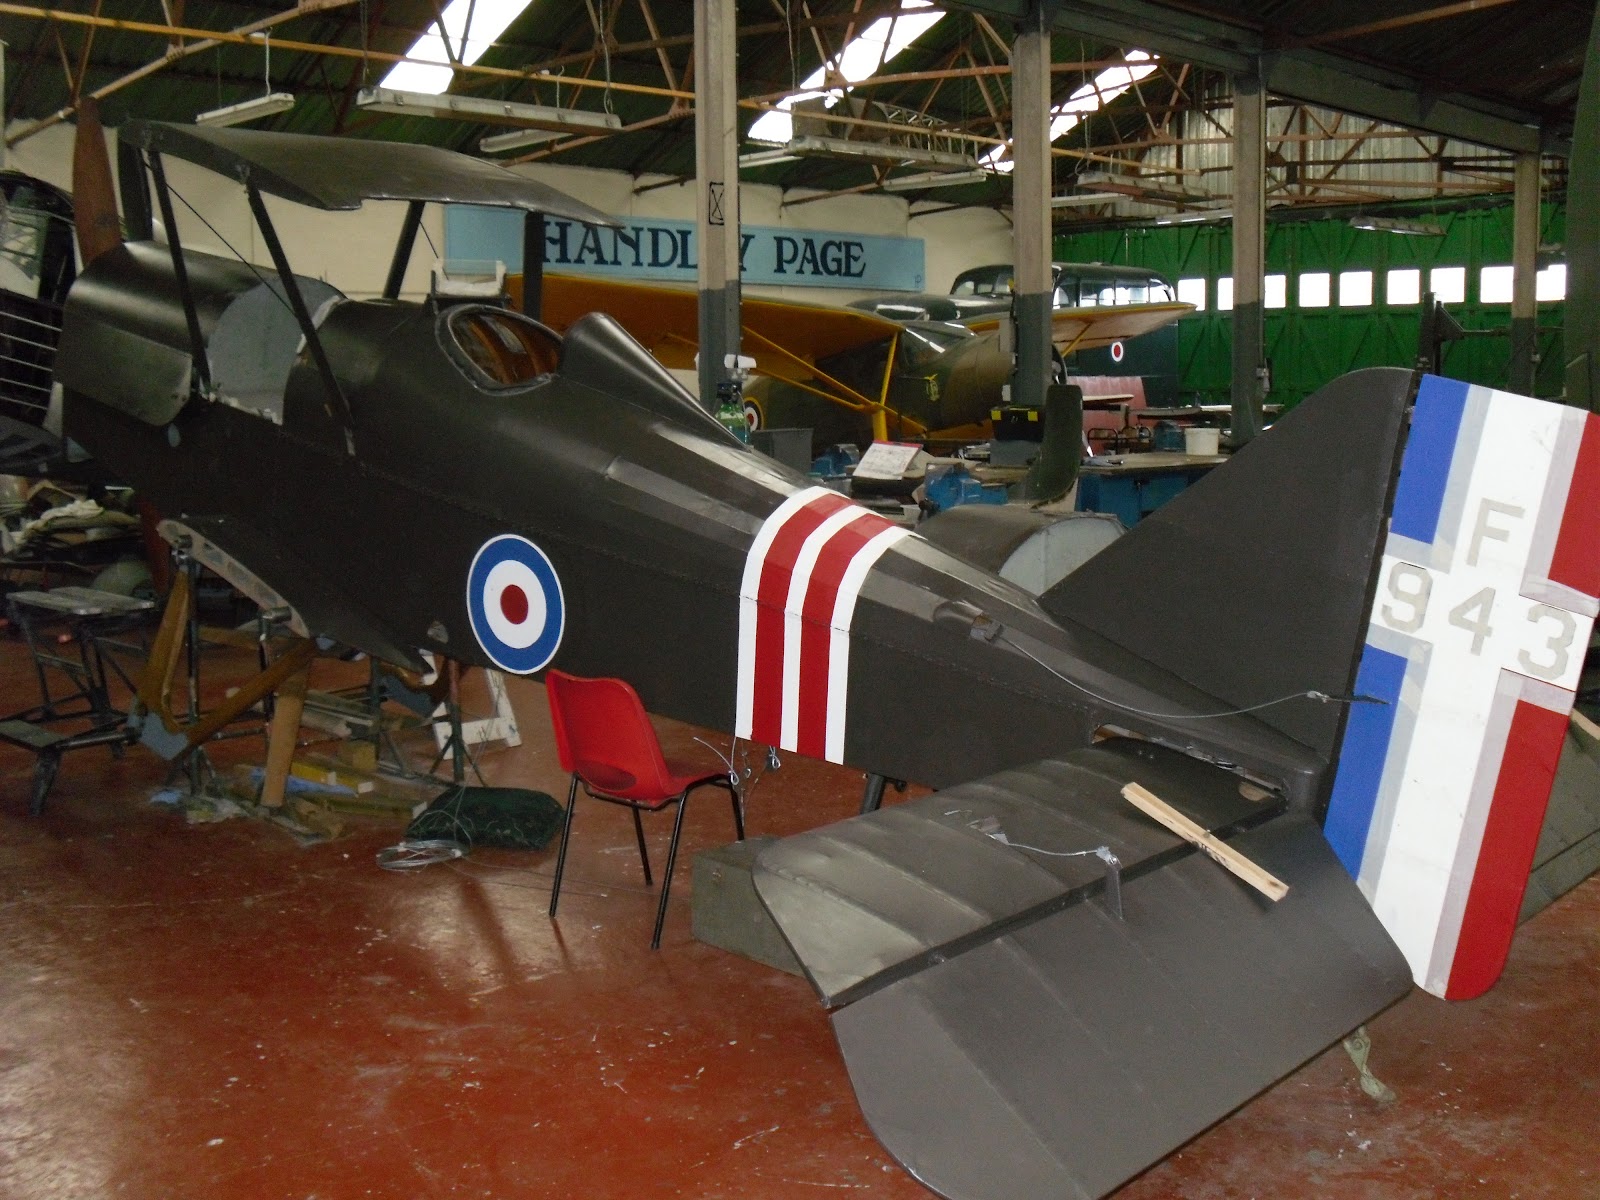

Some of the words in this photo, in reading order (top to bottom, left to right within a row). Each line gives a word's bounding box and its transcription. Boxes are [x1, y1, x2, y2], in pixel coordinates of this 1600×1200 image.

[542, 221, 755, 272] HANDLY
[773, 236, 867, 278] PAGE
[1466, 497, 1526, 568] F
[1381, 561, 1577, 681] 943
